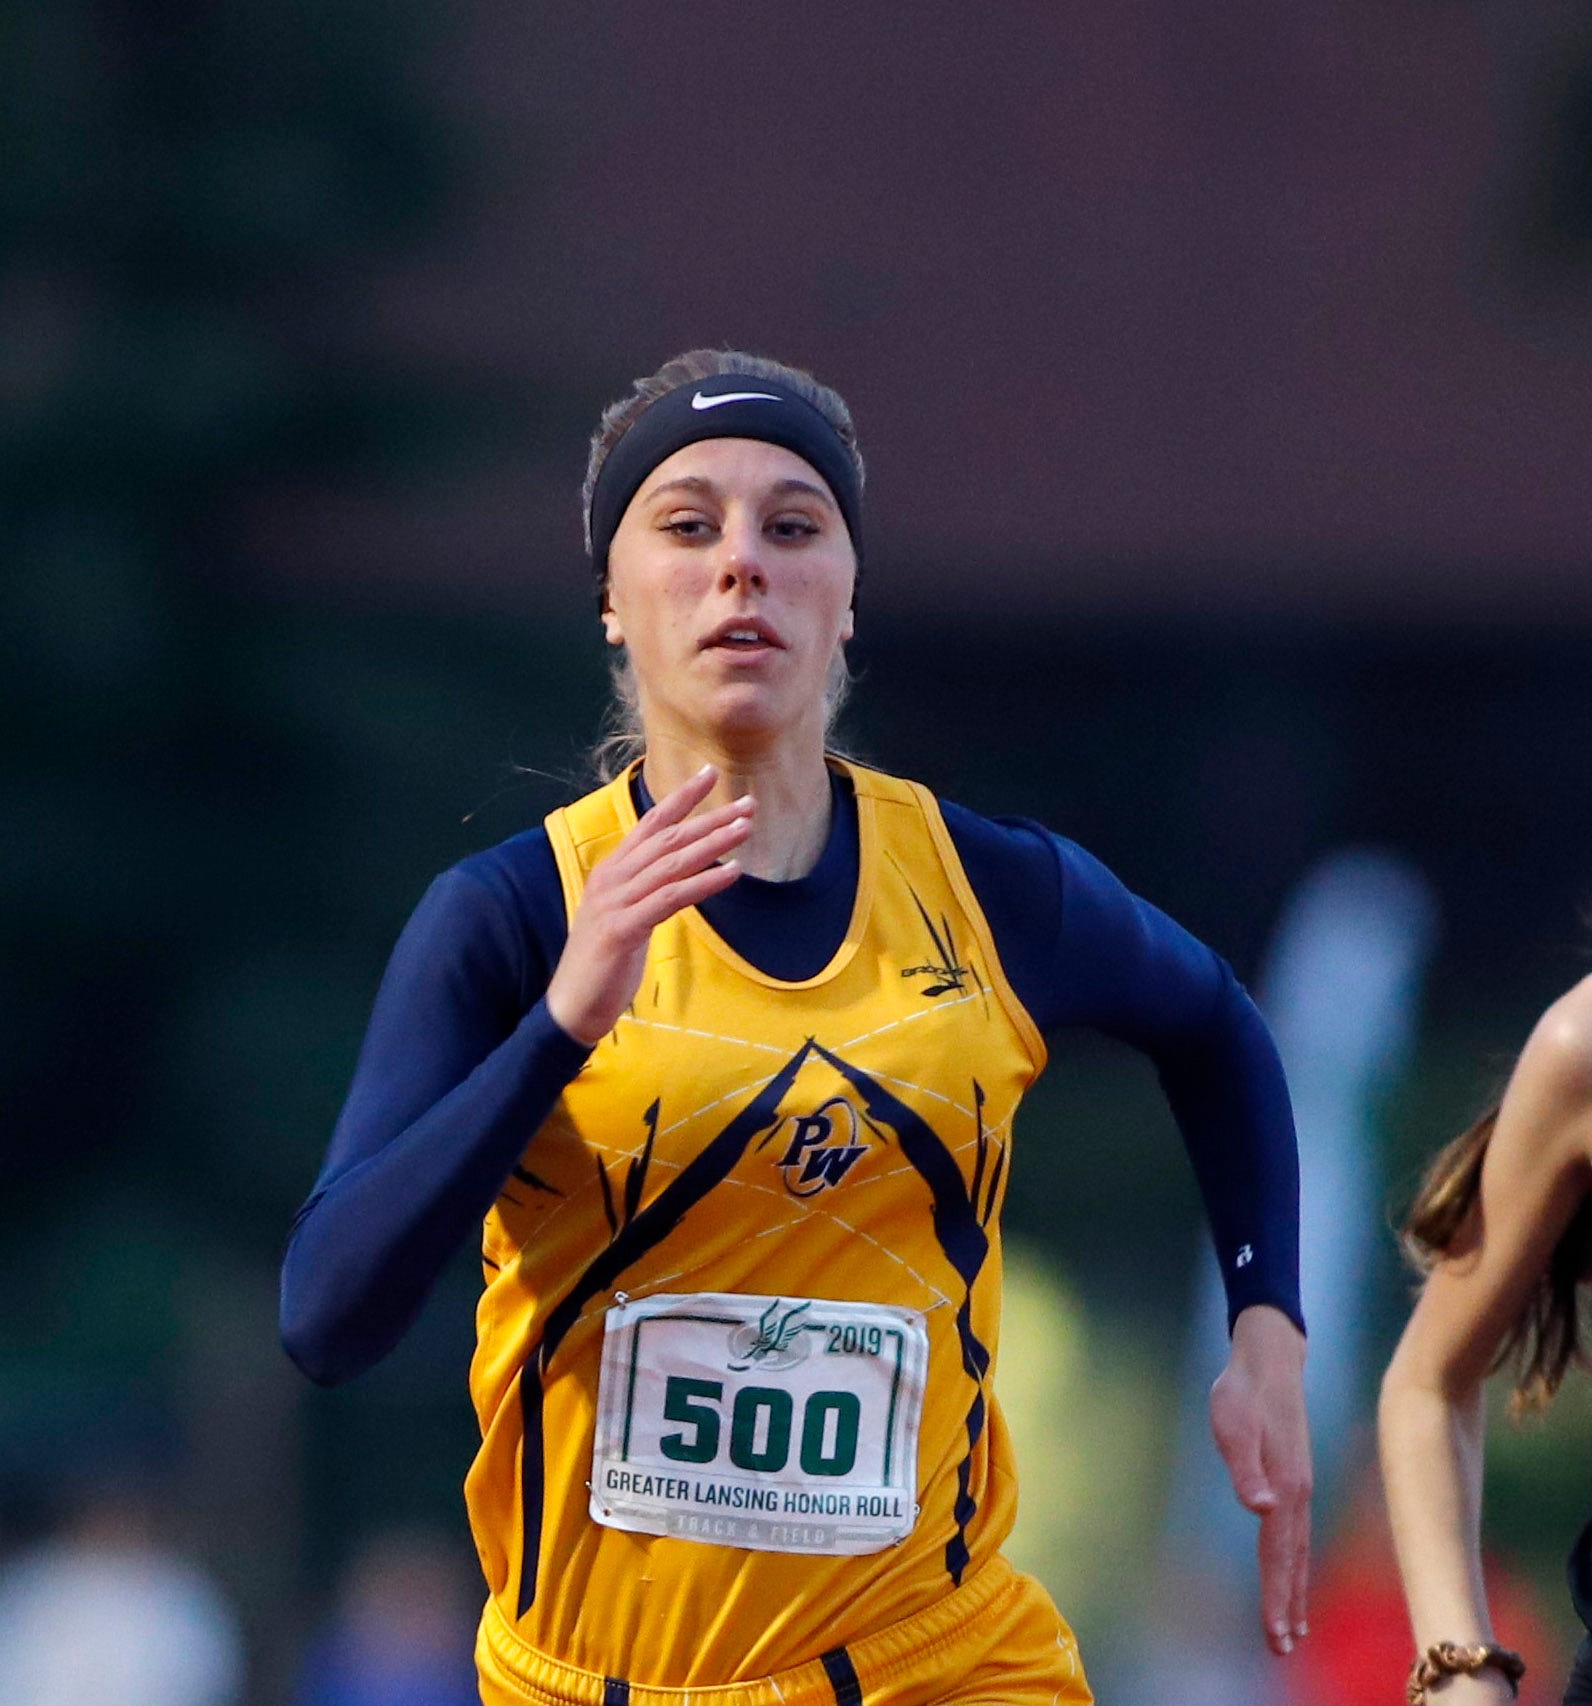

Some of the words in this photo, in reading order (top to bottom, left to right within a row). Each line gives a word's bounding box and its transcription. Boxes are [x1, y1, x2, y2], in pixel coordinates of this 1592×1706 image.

[826, 1324, 883, 1356] 2019
[659, 1376, 861, 1477] 500
[606, 1469, 689, 1501] GREATER
[694, 1483, 779, 1512] LANSING
[783, 1491, 851, 1517] HONOR
[854, 1495, 904, 1518] ROLL
[676, 1514, 738, 1539] TRACK
[769, 1526, 826, 1545] FIELD
